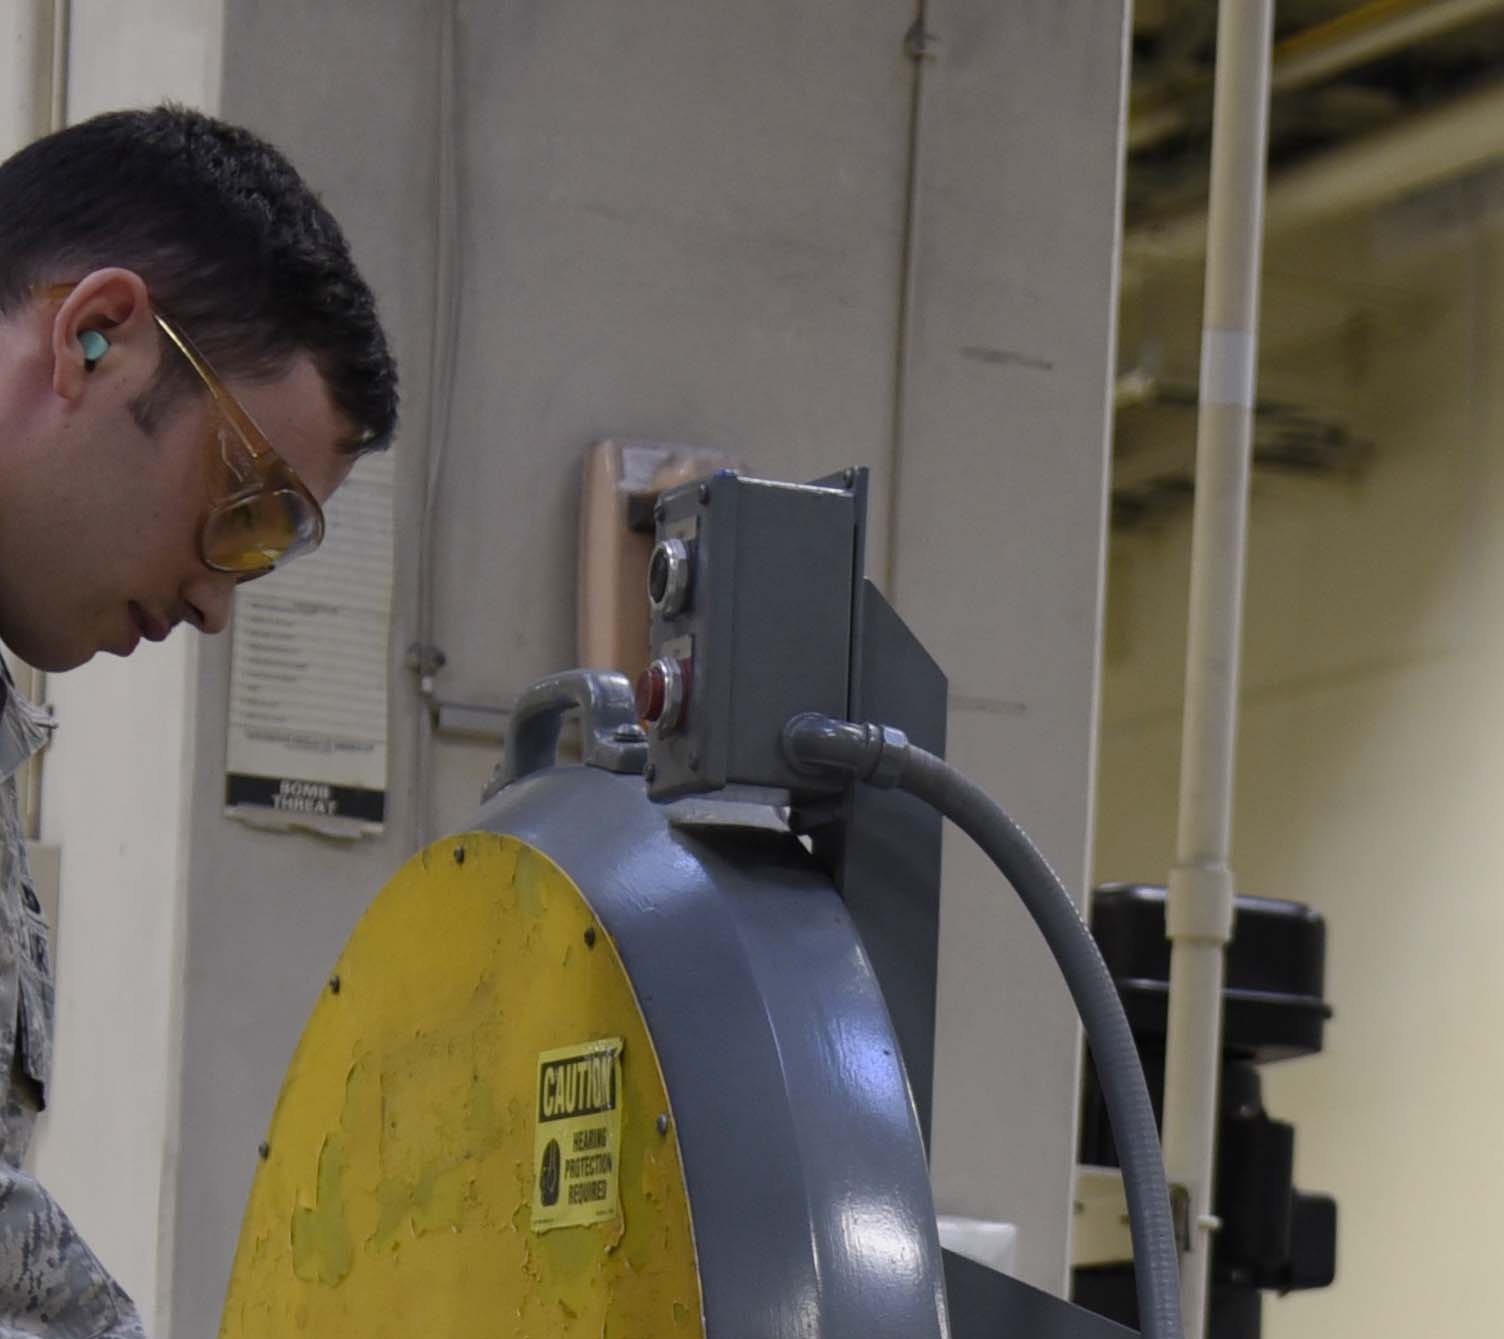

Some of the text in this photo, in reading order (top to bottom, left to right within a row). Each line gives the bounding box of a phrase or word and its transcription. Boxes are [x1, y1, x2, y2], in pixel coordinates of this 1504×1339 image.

[279, 781, 331, 798] BOMB
[271, 794, 338, 815] THREAT
[544, 1056, 612, 1117] CAUTION
[572, 1127, 607, 1152] HEARING
[565, 1153, 613, 1180] PROTECTION
[568, 1179, 608, 1206] REQUIRED
